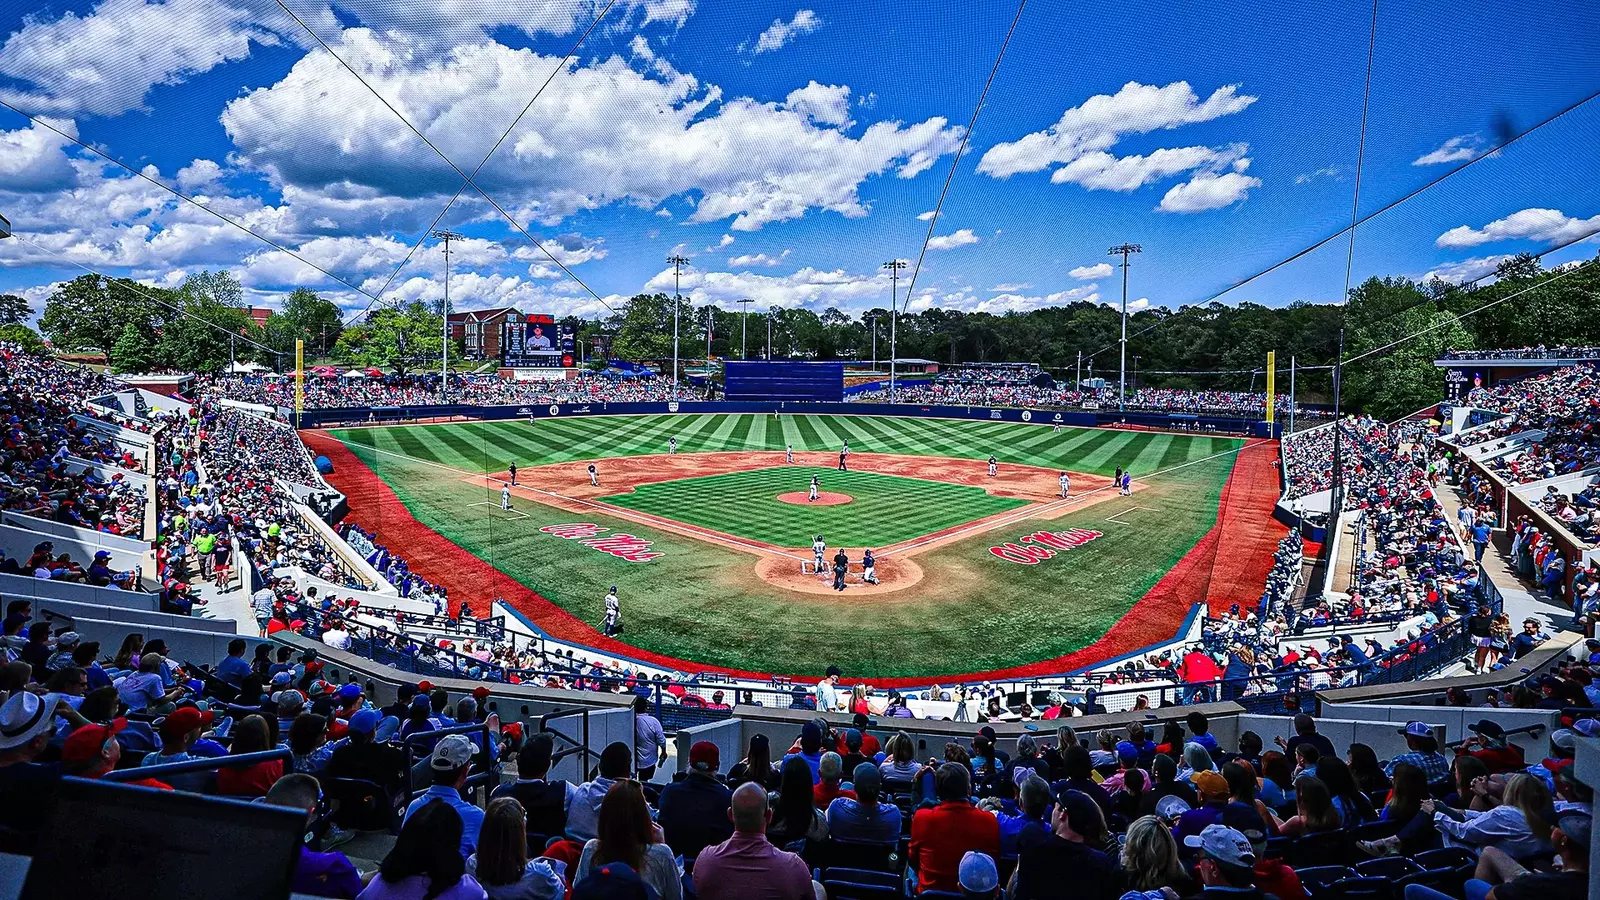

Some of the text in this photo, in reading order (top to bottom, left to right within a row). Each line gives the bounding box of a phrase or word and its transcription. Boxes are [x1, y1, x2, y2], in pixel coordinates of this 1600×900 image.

[539, 523, 666, 562] Ole Miss
[989, 528, 1103, 564] Ole Miss
